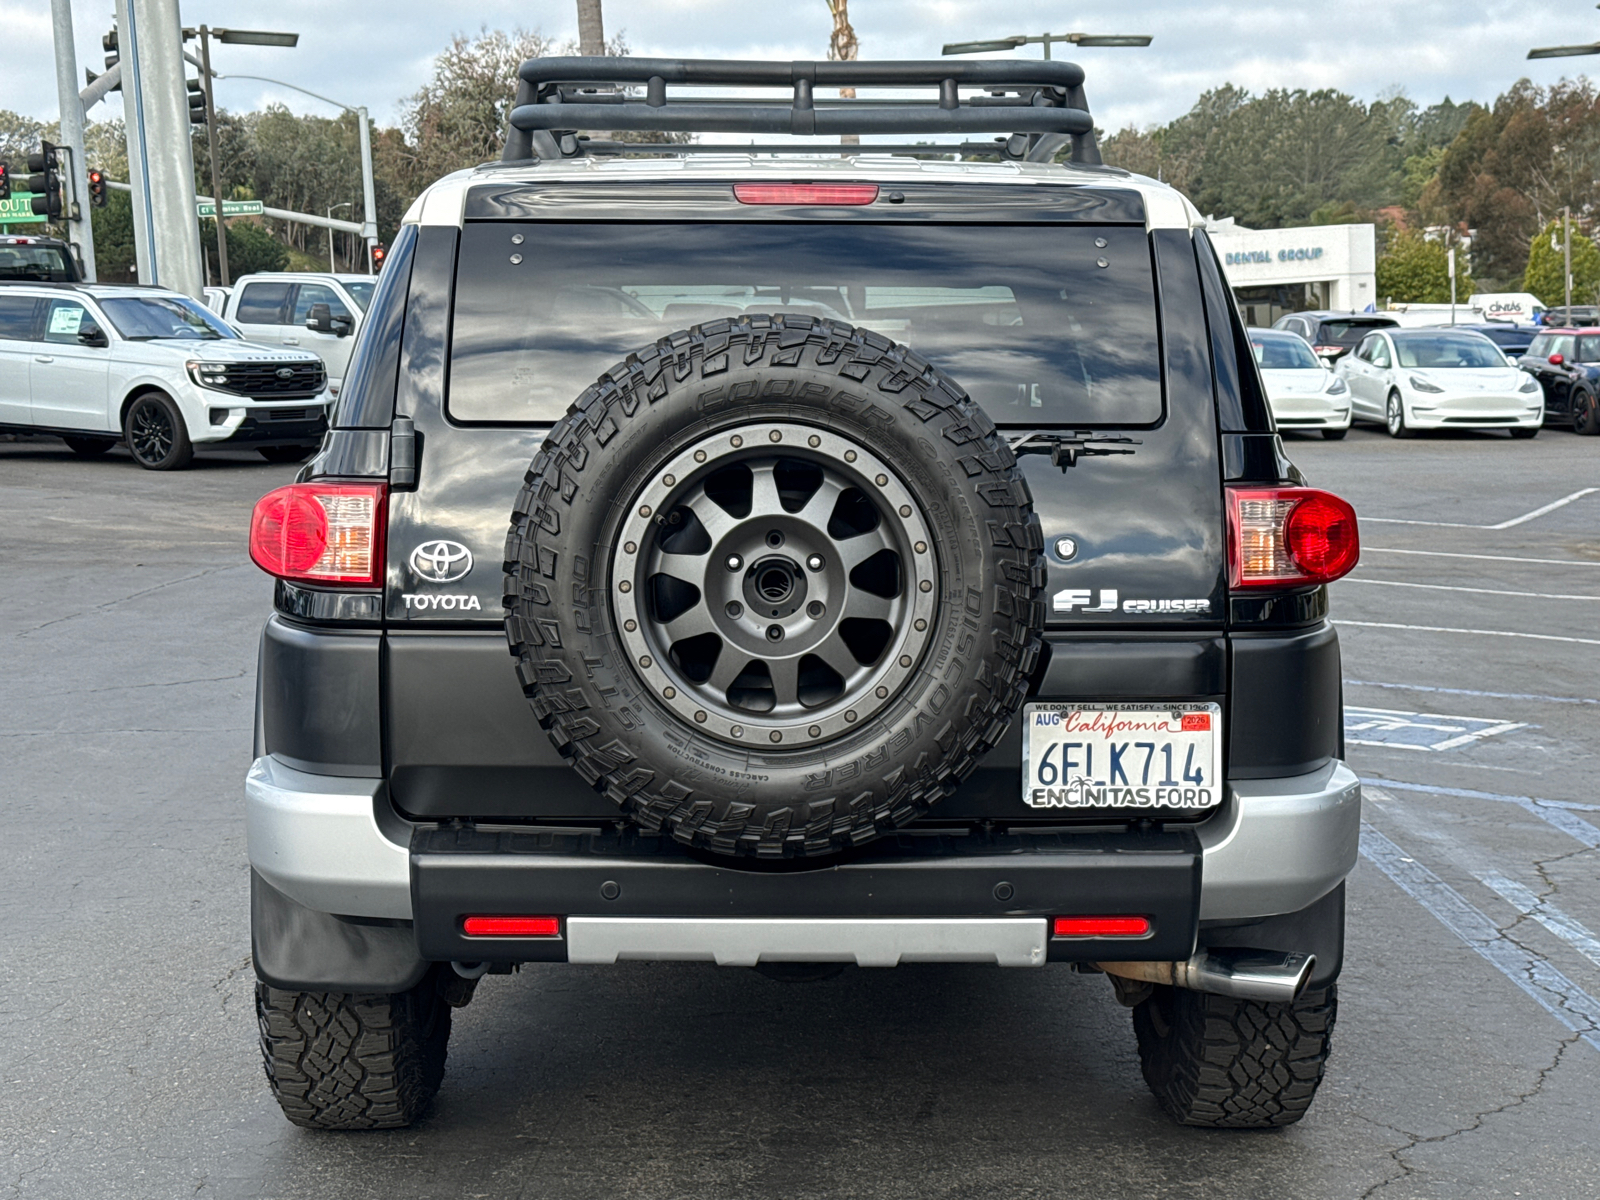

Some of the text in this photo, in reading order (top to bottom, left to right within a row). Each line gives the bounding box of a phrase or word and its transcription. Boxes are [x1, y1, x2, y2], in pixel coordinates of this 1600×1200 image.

[1225, 248, 1323, 265] DENTAL GROUP
[695, 378, 897, 431] COOPER
[586, 423, 649, 503] LT265/70R17
[402, 594, 481, 610] TOYOTA
[572, 554, 592, 636] PRO
[1053, 589, 1212, 613] FJ CRUISER
[935, 609, 959, 670] LT265/70R17
[577, 649, 644, 732] STT
[804, 585, 983, 791] DISCOVERER
[1035, 711, 1206, 739] AUG California 2026
[666, 743, 726, 775] CONSTRUCTION
[728, 770, 768, 782] CARCASS
[1037, 742, 1204, 787] 6FLK714
[1032, 788, 1212, 806] ENCINITAS FORD
